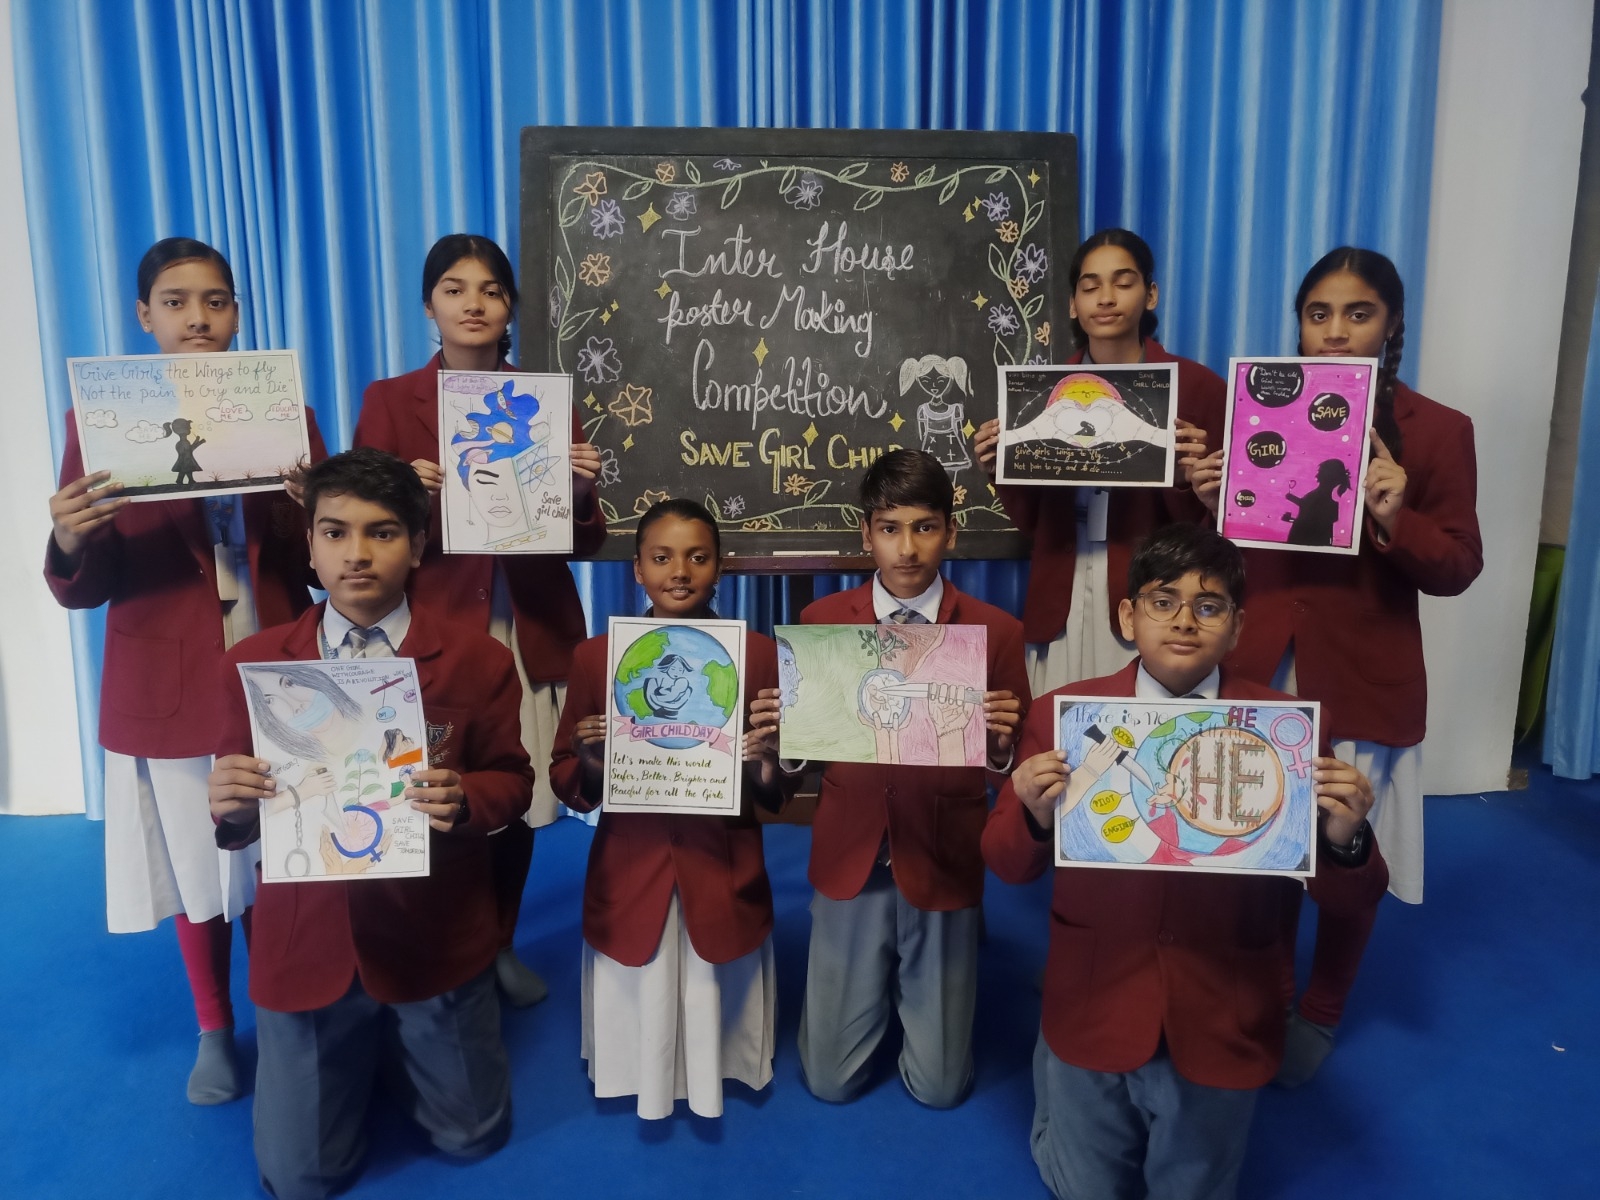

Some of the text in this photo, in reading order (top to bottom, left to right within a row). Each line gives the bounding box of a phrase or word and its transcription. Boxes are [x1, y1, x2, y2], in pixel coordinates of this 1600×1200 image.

[659, 220, 914, 280] Inter House
[760, 284, 873, 358] Making
[121, 362, 163, 384] Girls
[166, 361, 190, 380] the
[237, 361, 250, 376] to
[253, 361, 277, 381] fly
[693, 338, 888, 431] Competition
[80, 385, 106, 401] Not
[110, 384, 132, 400] the
[140, 386, 176, 404] pain
[184, 384, 195, 398] to
[234, 383, 261, 395] and
[220, 406, 243, 414] LOVE
[1315, 406, 1347, 419] SAVE
[680, 428, 754, 468] SAVE
[1249, 442, 1280, 457] GIRL
[1013, 462, 1026, 470] Not
[1045, 462, 1052, 470] to
[541, 491, 562, 505] Save
[535, 505, 570, 521] girl child
[1075, 706, 1114, 724] There
[631, 724, 714, 738] GIRL CHILD DAY
[612, 752, 712, 768] Let's make this world
[710, 776, 727, 784] and
[645, 786, 660, 801] for
[664, 787, 679, 797] all
[685, 788, 697, 798] the
[1092, 794, 1115, 808] PILOT
[392, 815, 415, 825] SAVE
[394, 825, 415, 834] GIRL
